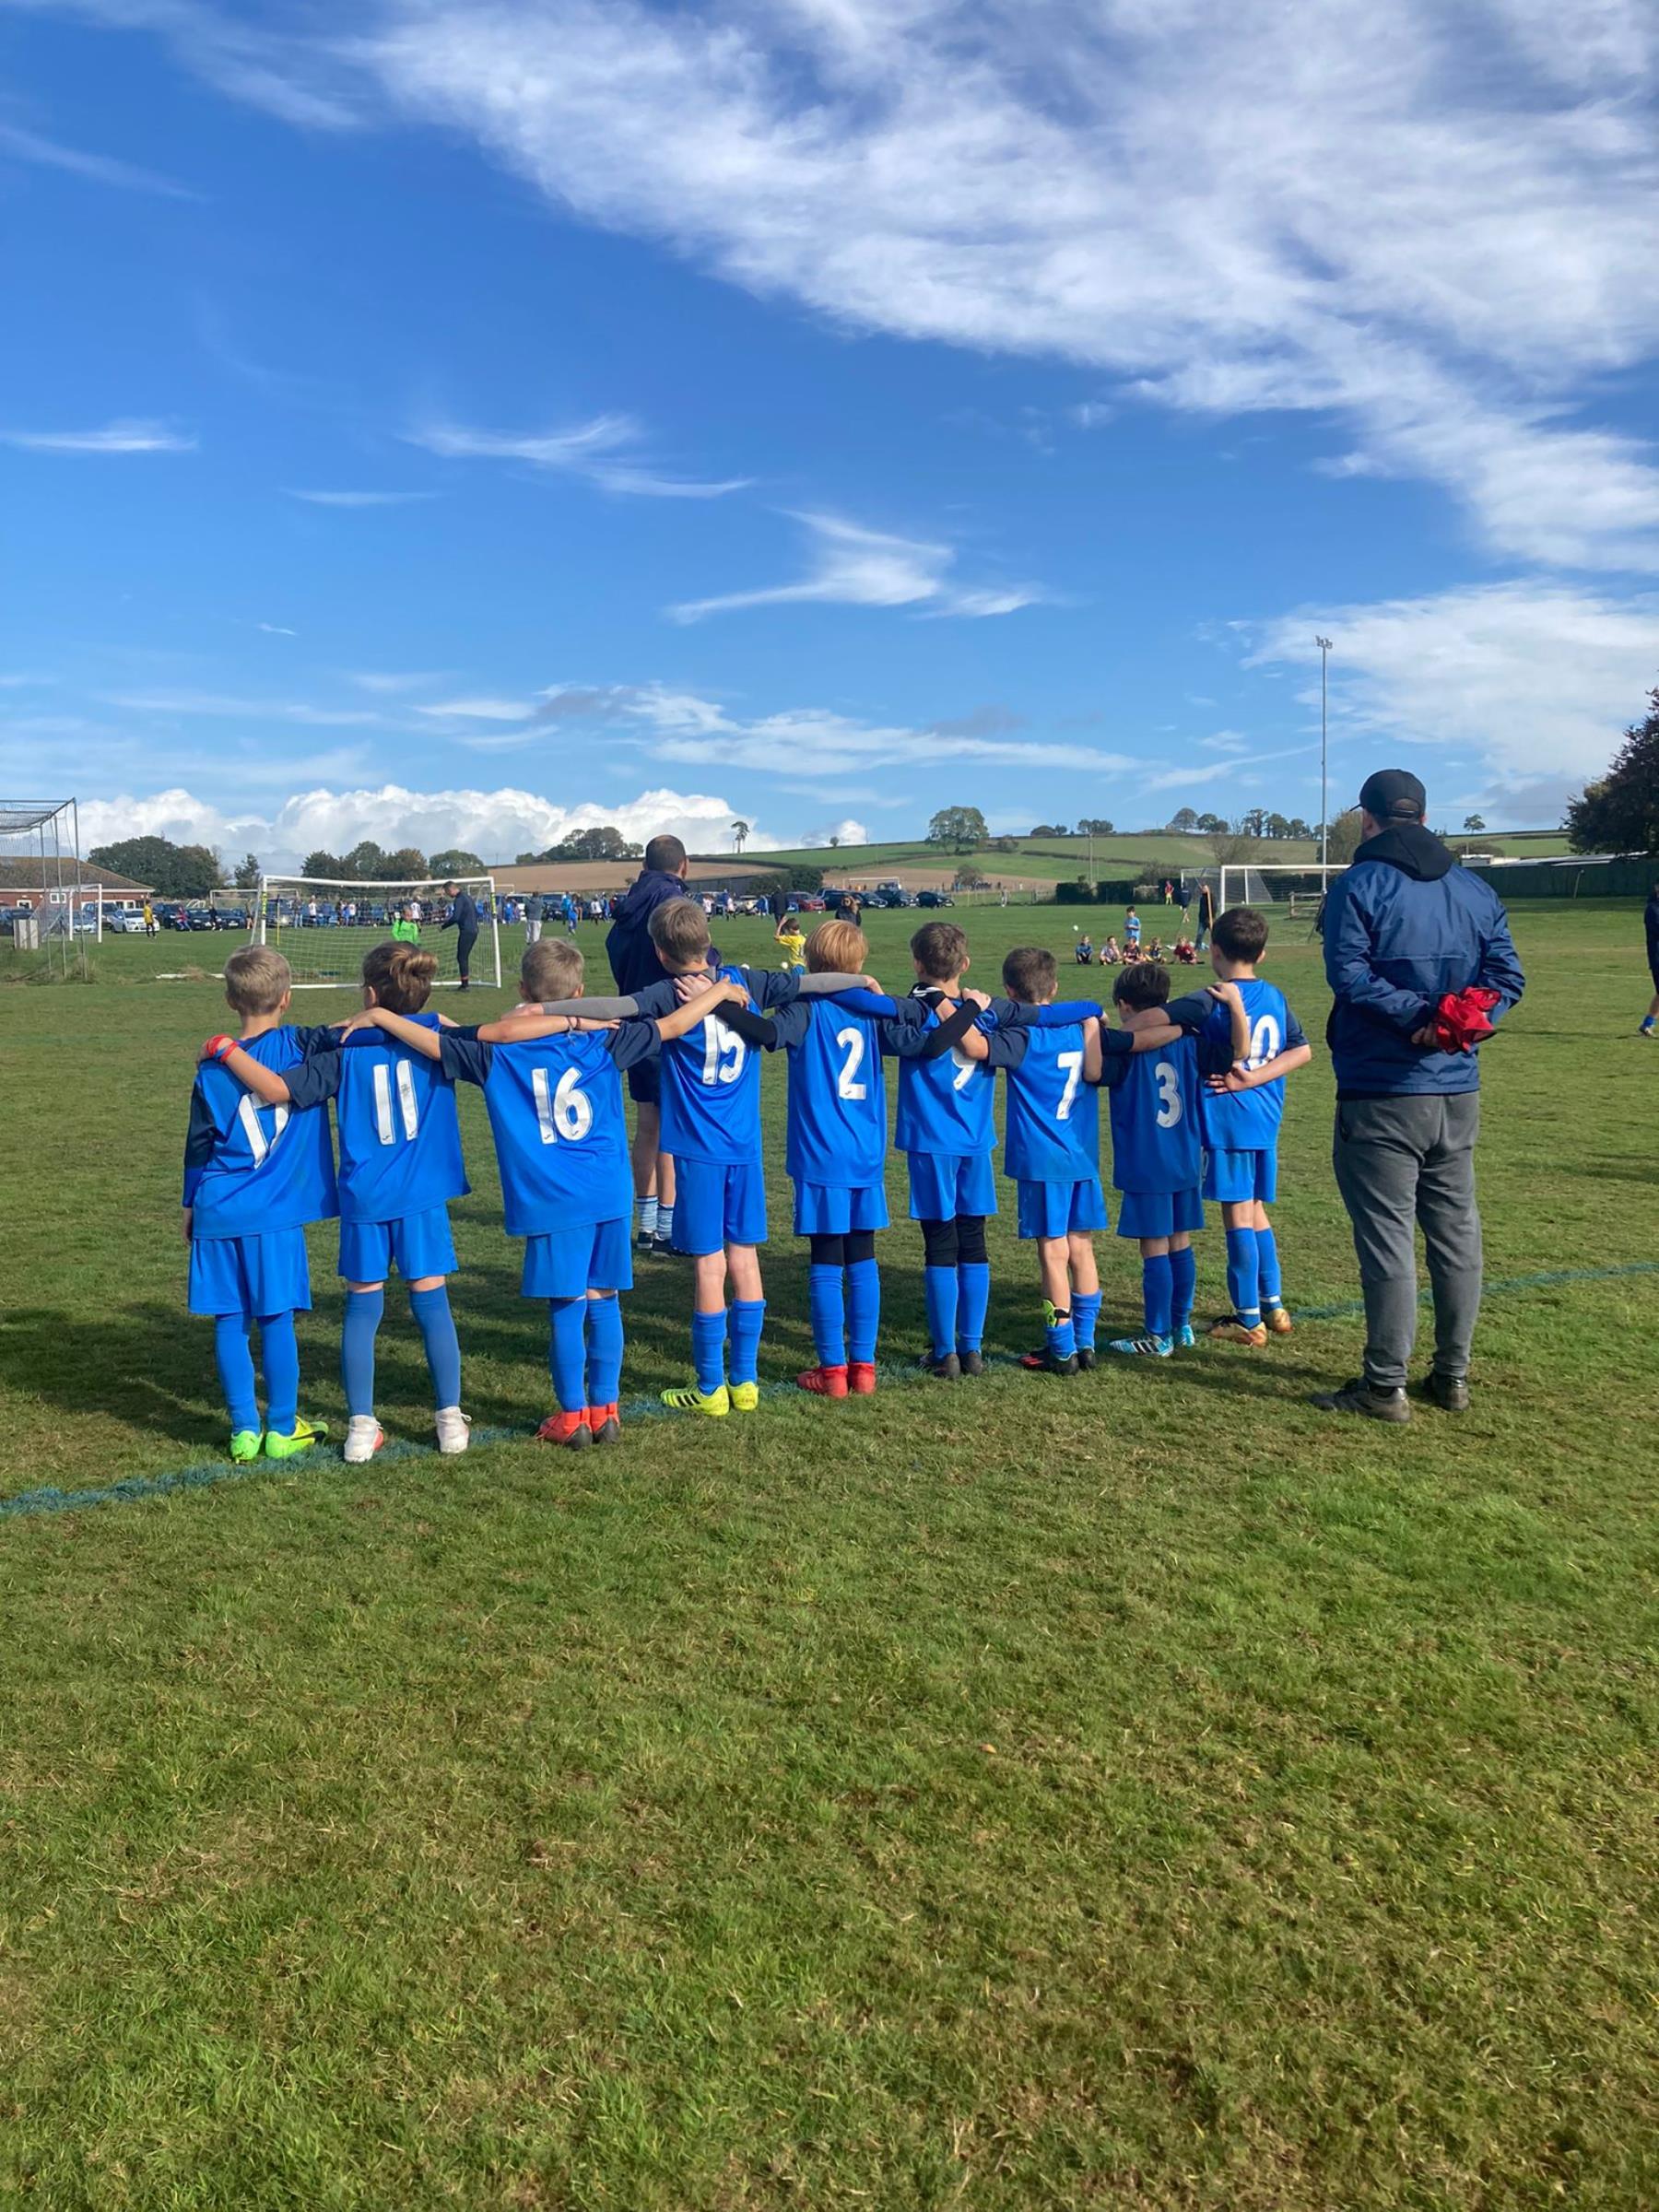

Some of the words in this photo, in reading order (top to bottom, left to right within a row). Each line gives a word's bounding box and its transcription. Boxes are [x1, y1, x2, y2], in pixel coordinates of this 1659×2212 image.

[702, 1014, 747, 1085] 15
[837, 1028, 866, 1100] 2
[372, 1059, 419, 1145] 11
[532, 1066, 593, 1144] 16
[1056, 1051, 1084, 1120] 7
[1155, 1062, 1182, 1128] 3
